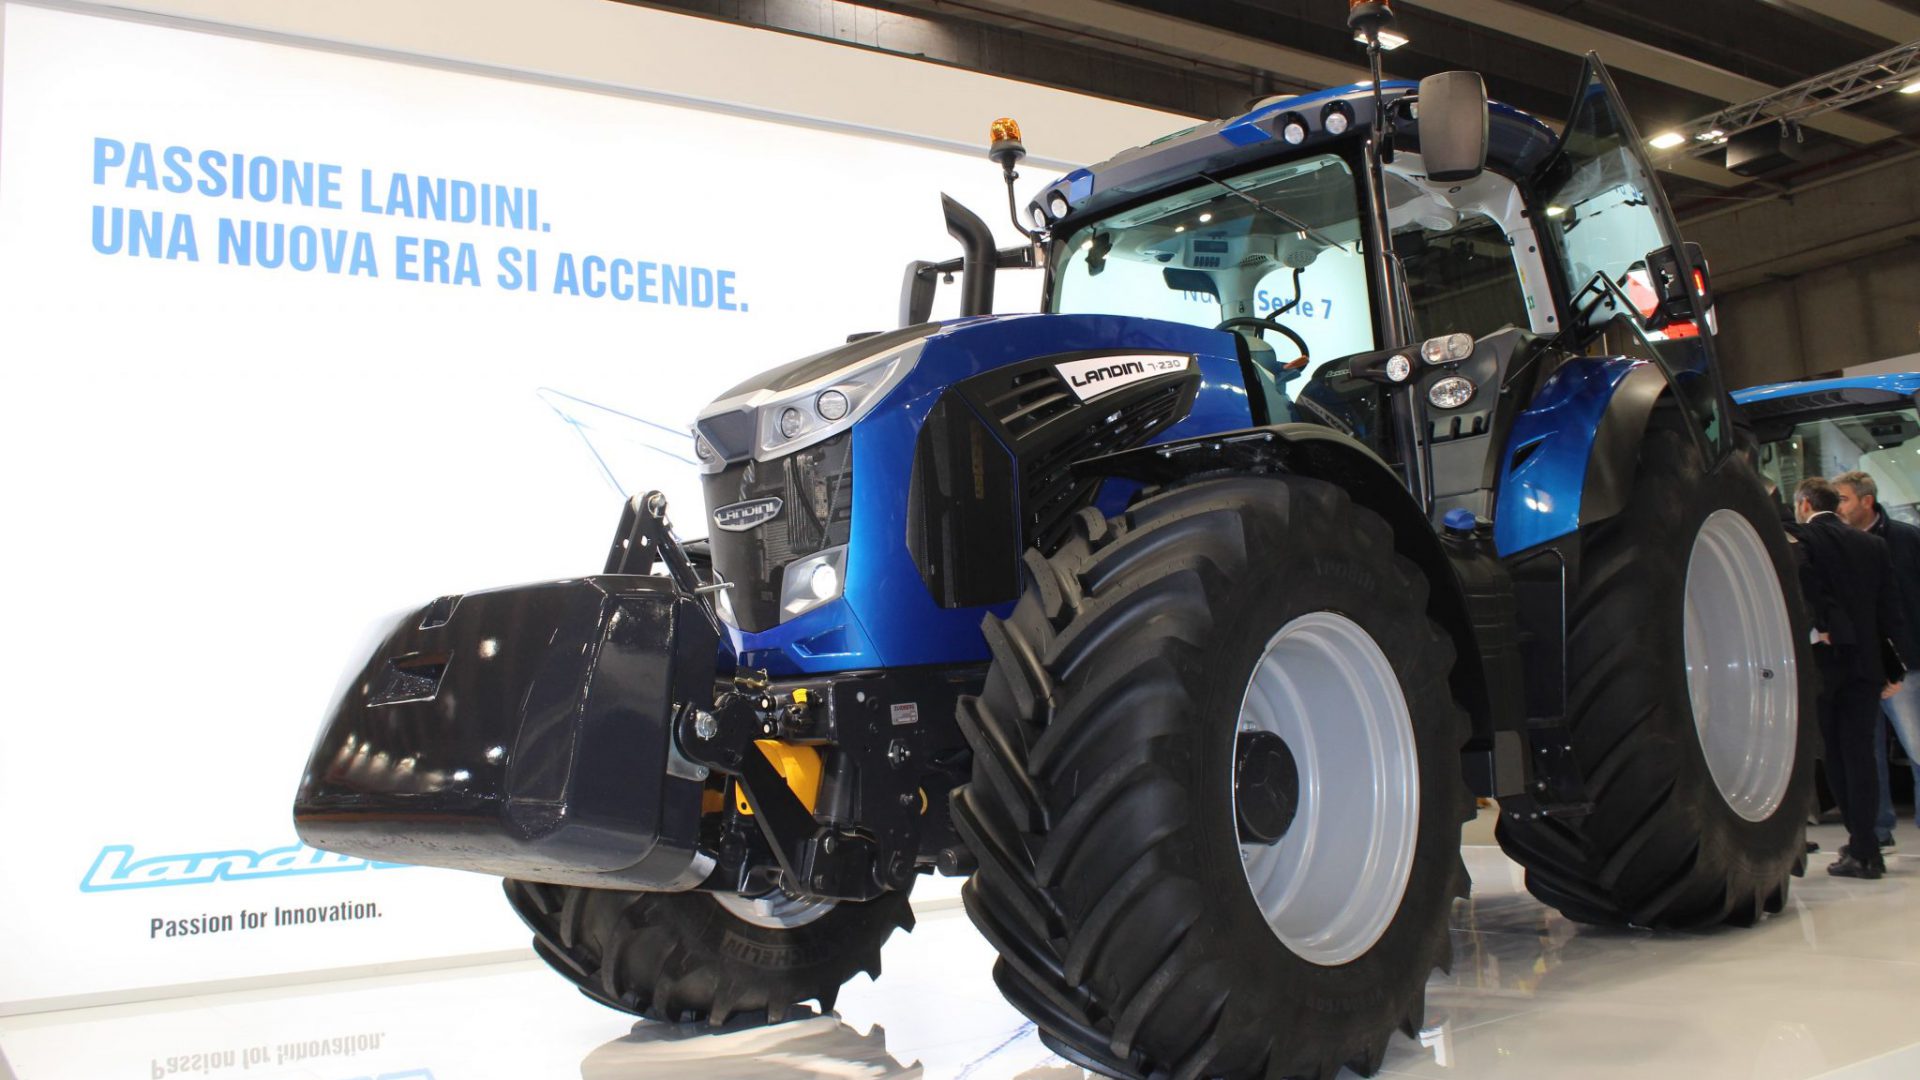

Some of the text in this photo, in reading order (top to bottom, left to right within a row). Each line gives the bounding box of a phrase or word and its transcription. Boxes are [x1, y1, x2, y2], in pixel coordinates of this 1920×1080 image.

[94, 138, 551, 233] PASSIONE LANDINI.
[91, 206, 749, 313] UNA NUOVA ERA SI ACCENDE.
[1321, 299, 1332, 320] 7
[1071, 361, 1145, 387] LANDINI
[717, 502, 774, 522] LANDINI
[150, 900, 383, 939] Passion for Innovation.
